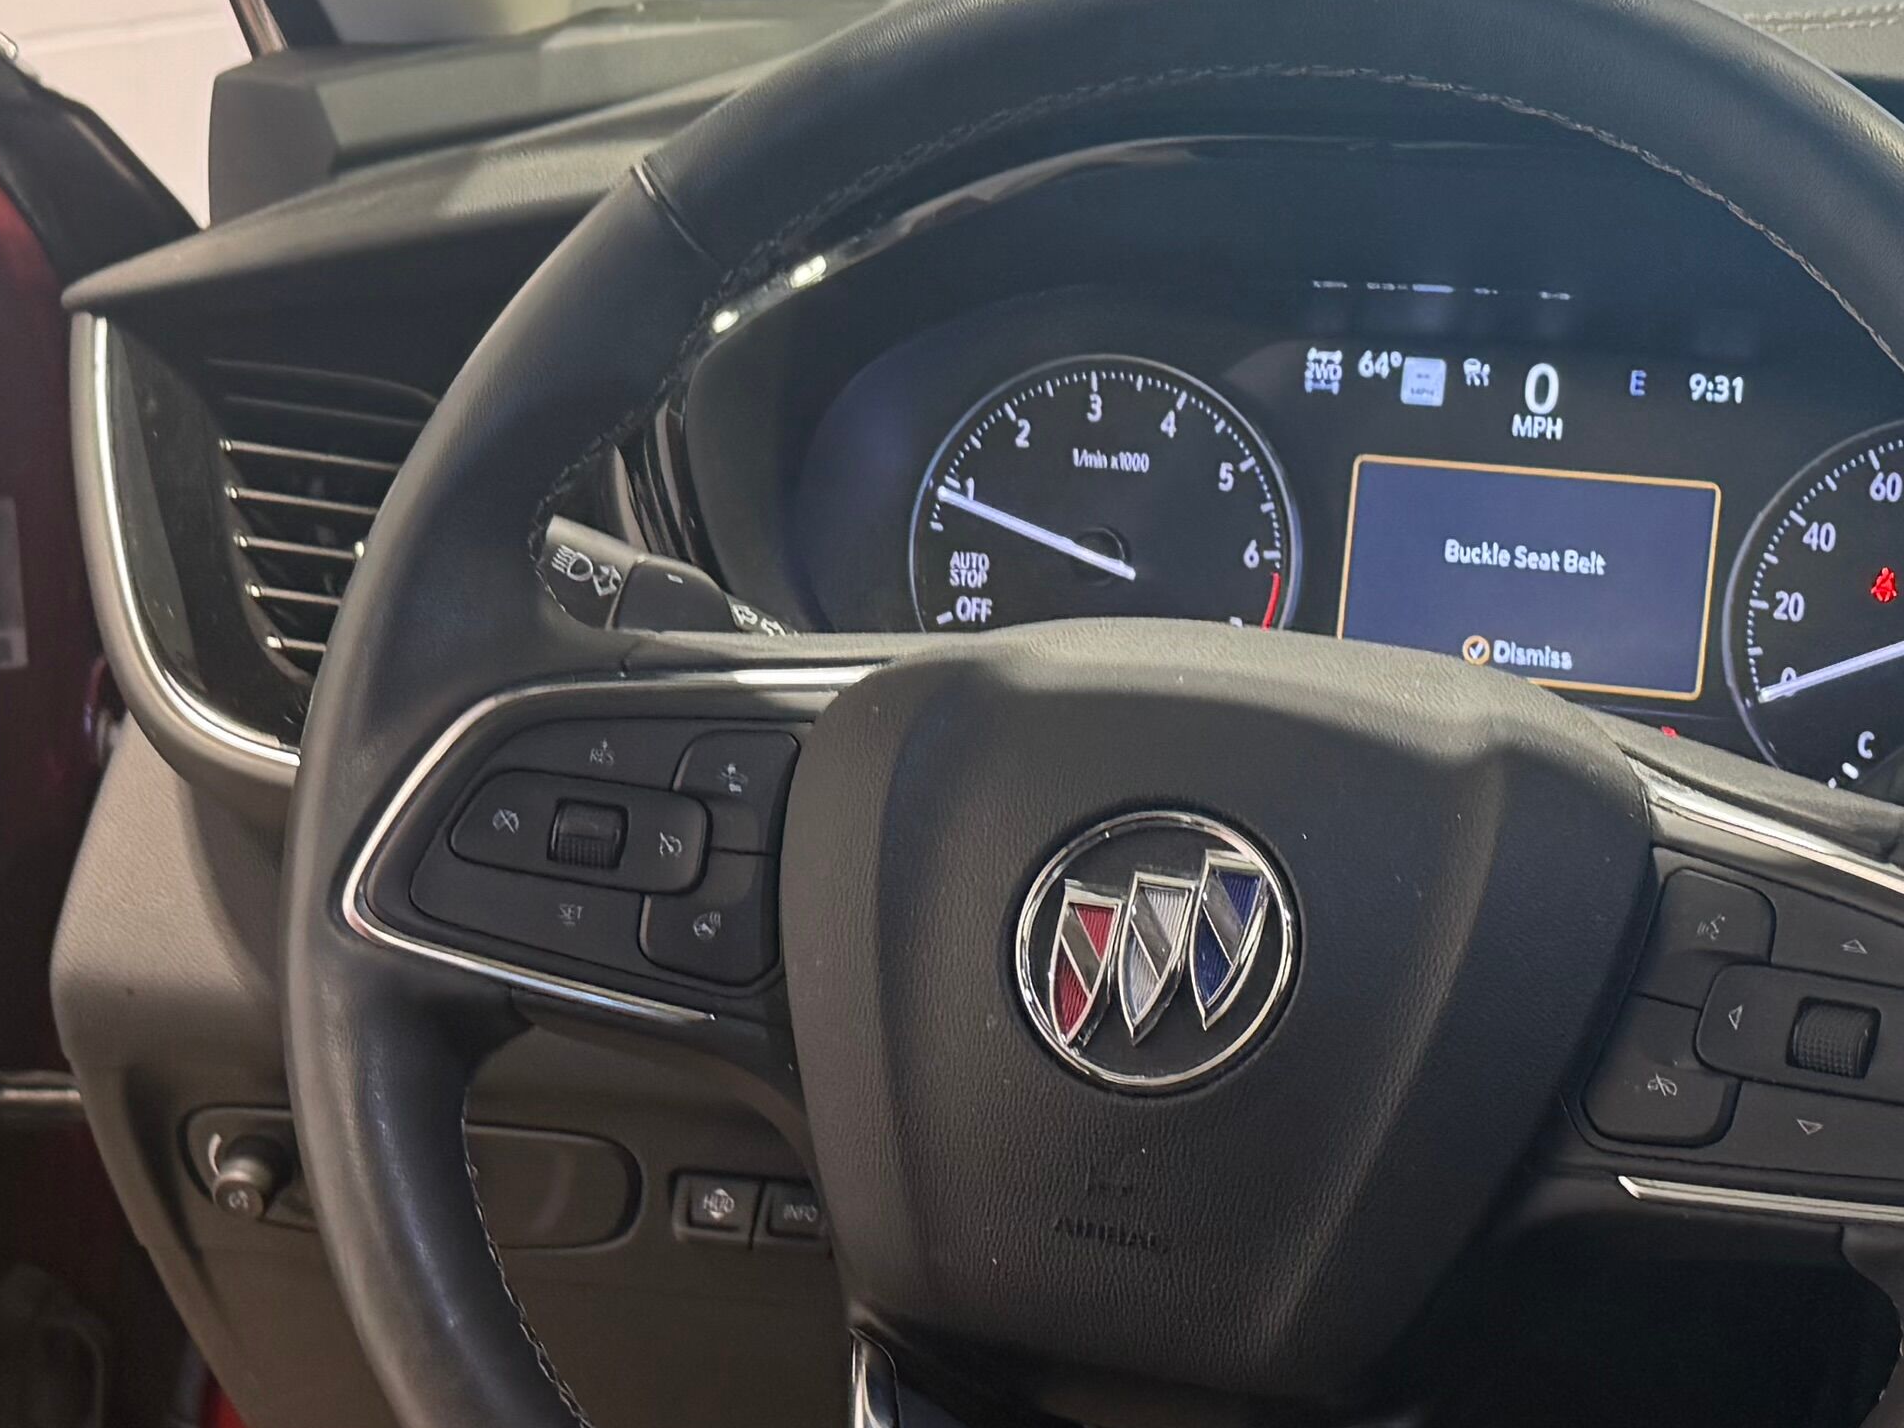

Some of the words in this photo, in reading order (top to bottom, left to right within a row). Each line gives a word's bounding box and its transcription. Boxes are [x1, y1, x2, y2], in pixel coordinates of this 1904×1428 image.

[1524, 363, 1561, 415] 0
[1629, 370, 1648, 397] E
[1688, 373, 1745, 404] 9:31
[1087, 394, 1103, 423] 3
[1015, 418, 1031, 449] 2
[1160, 412, 1177, 439] 4
[1511, 414, 1564, 441] MPH
[1218, 463, 1235, 491] 5
[1869, 472, 1902, 503] 60
[1802, 521, 1837, 553] 40
[949, 550, 990, 572] AUTO
[1243, 540, 1260, 569] 6
[1444, 538, 1511, 568] Buckle
[1513, 545, 1560, 573] Seat
[1563, 550, 1607, 576] Belt
[949, 569, 988, 589] STOP
[955, 595, 993, 623] OFF
[1773, 590, 1805, 622] 20
[1493, 639, 1573, 671] Dismiss
